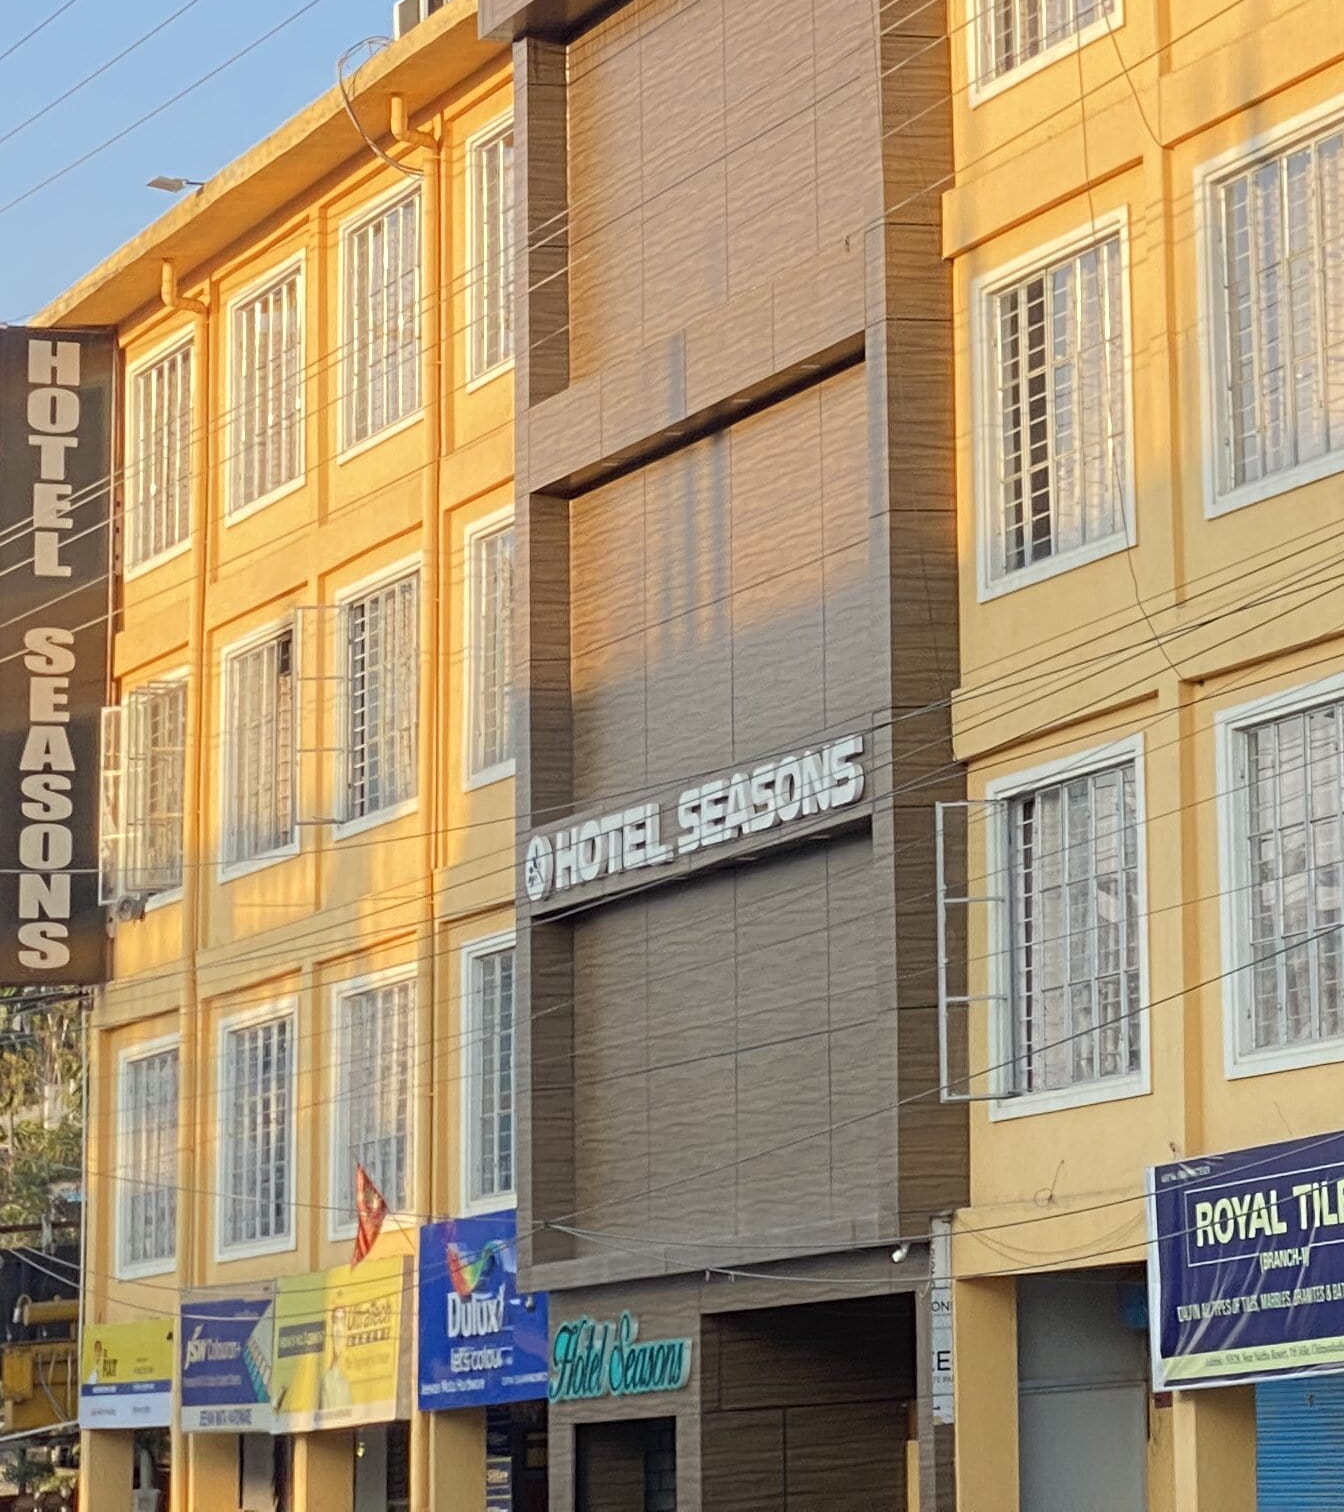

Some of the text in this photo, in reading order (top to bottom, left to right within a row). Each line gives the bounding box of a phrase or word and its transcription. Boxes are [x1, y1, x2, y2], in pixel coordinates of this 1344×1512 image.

[18, 340, 80, 968] HOTEL SEASONS
[555, 735, 865, 890] HOTEL SEASONS
[1195, 1190, 1287, 1247] ROYAL
[447, 1292, 501, 1338] Dulux
[550, 1311, 691, 1402] Hotel Seasons
